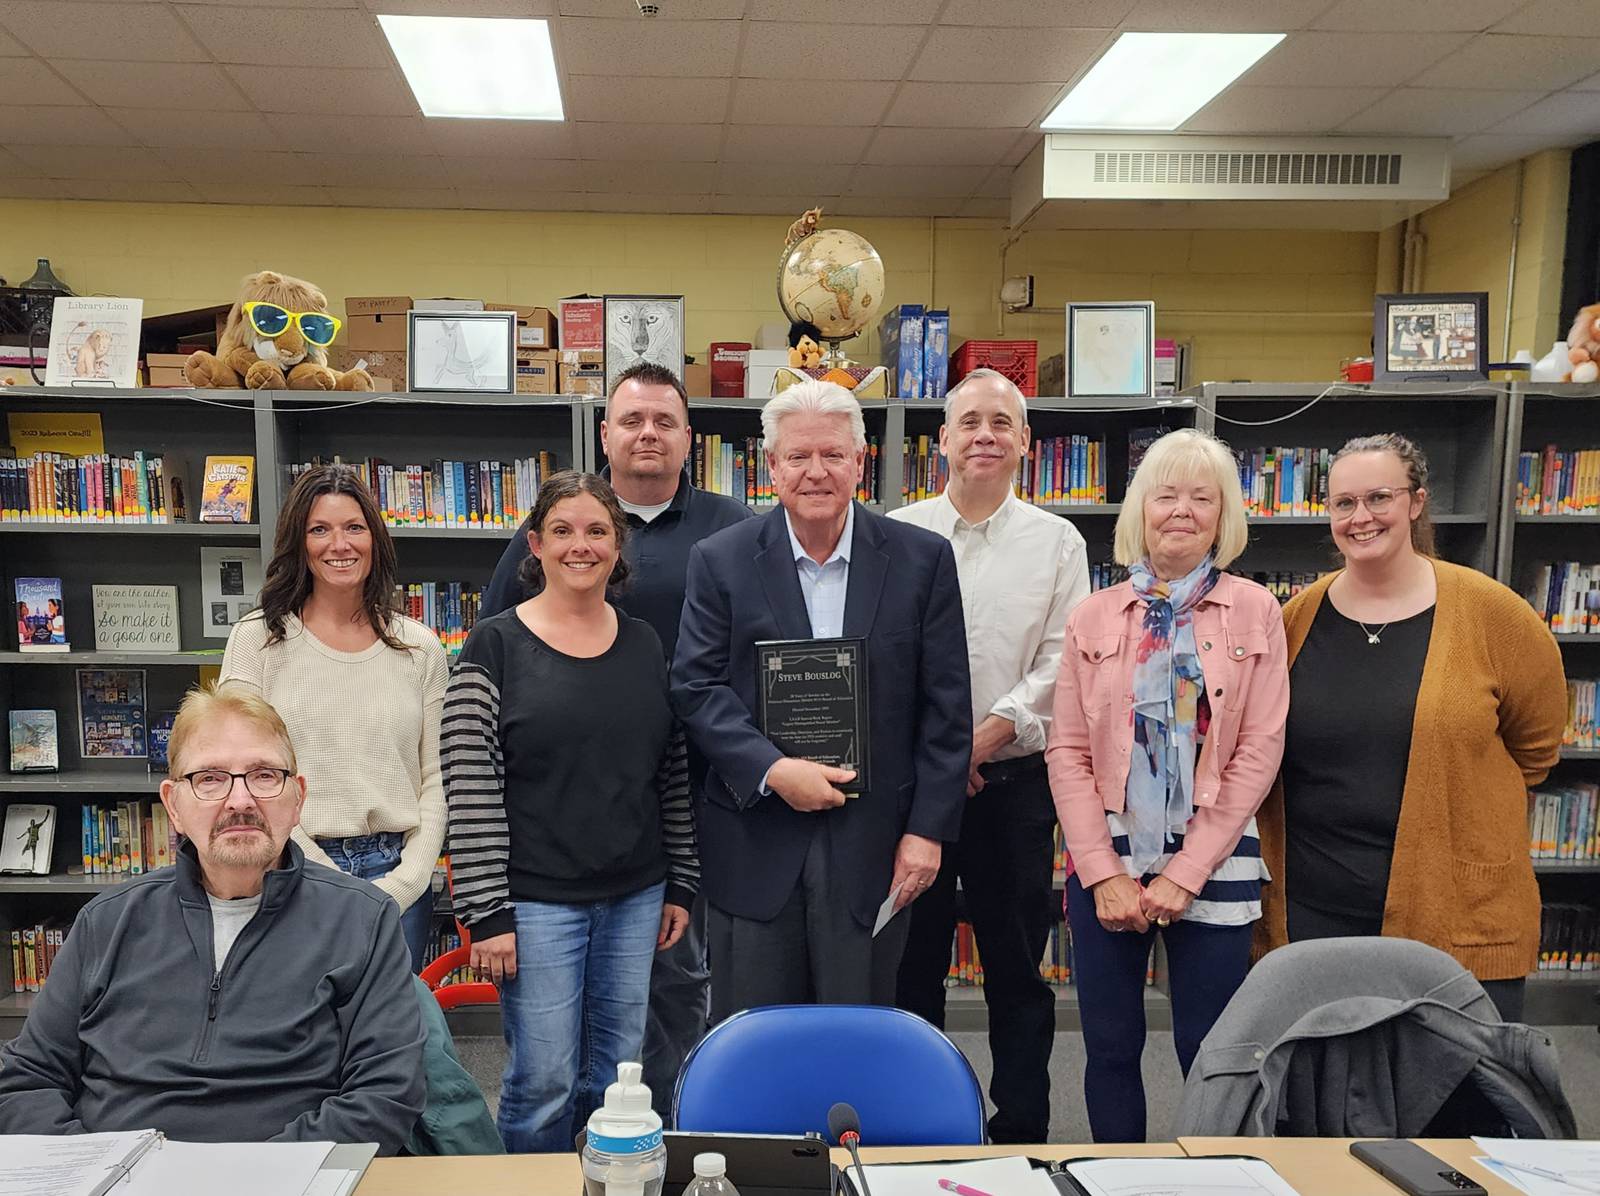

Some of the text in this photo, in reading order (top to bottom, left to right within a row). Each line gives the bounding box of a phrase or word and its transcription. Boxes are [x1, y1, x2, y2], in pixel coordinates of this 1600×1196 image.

[68, 301, 129, 312] Library Lion
[18, 581, 58, 592] Thousand
[128, 588, 141, 597] the
[98, 610, 172, 628] So make it
[100, 629, 174, 648] a good one.
